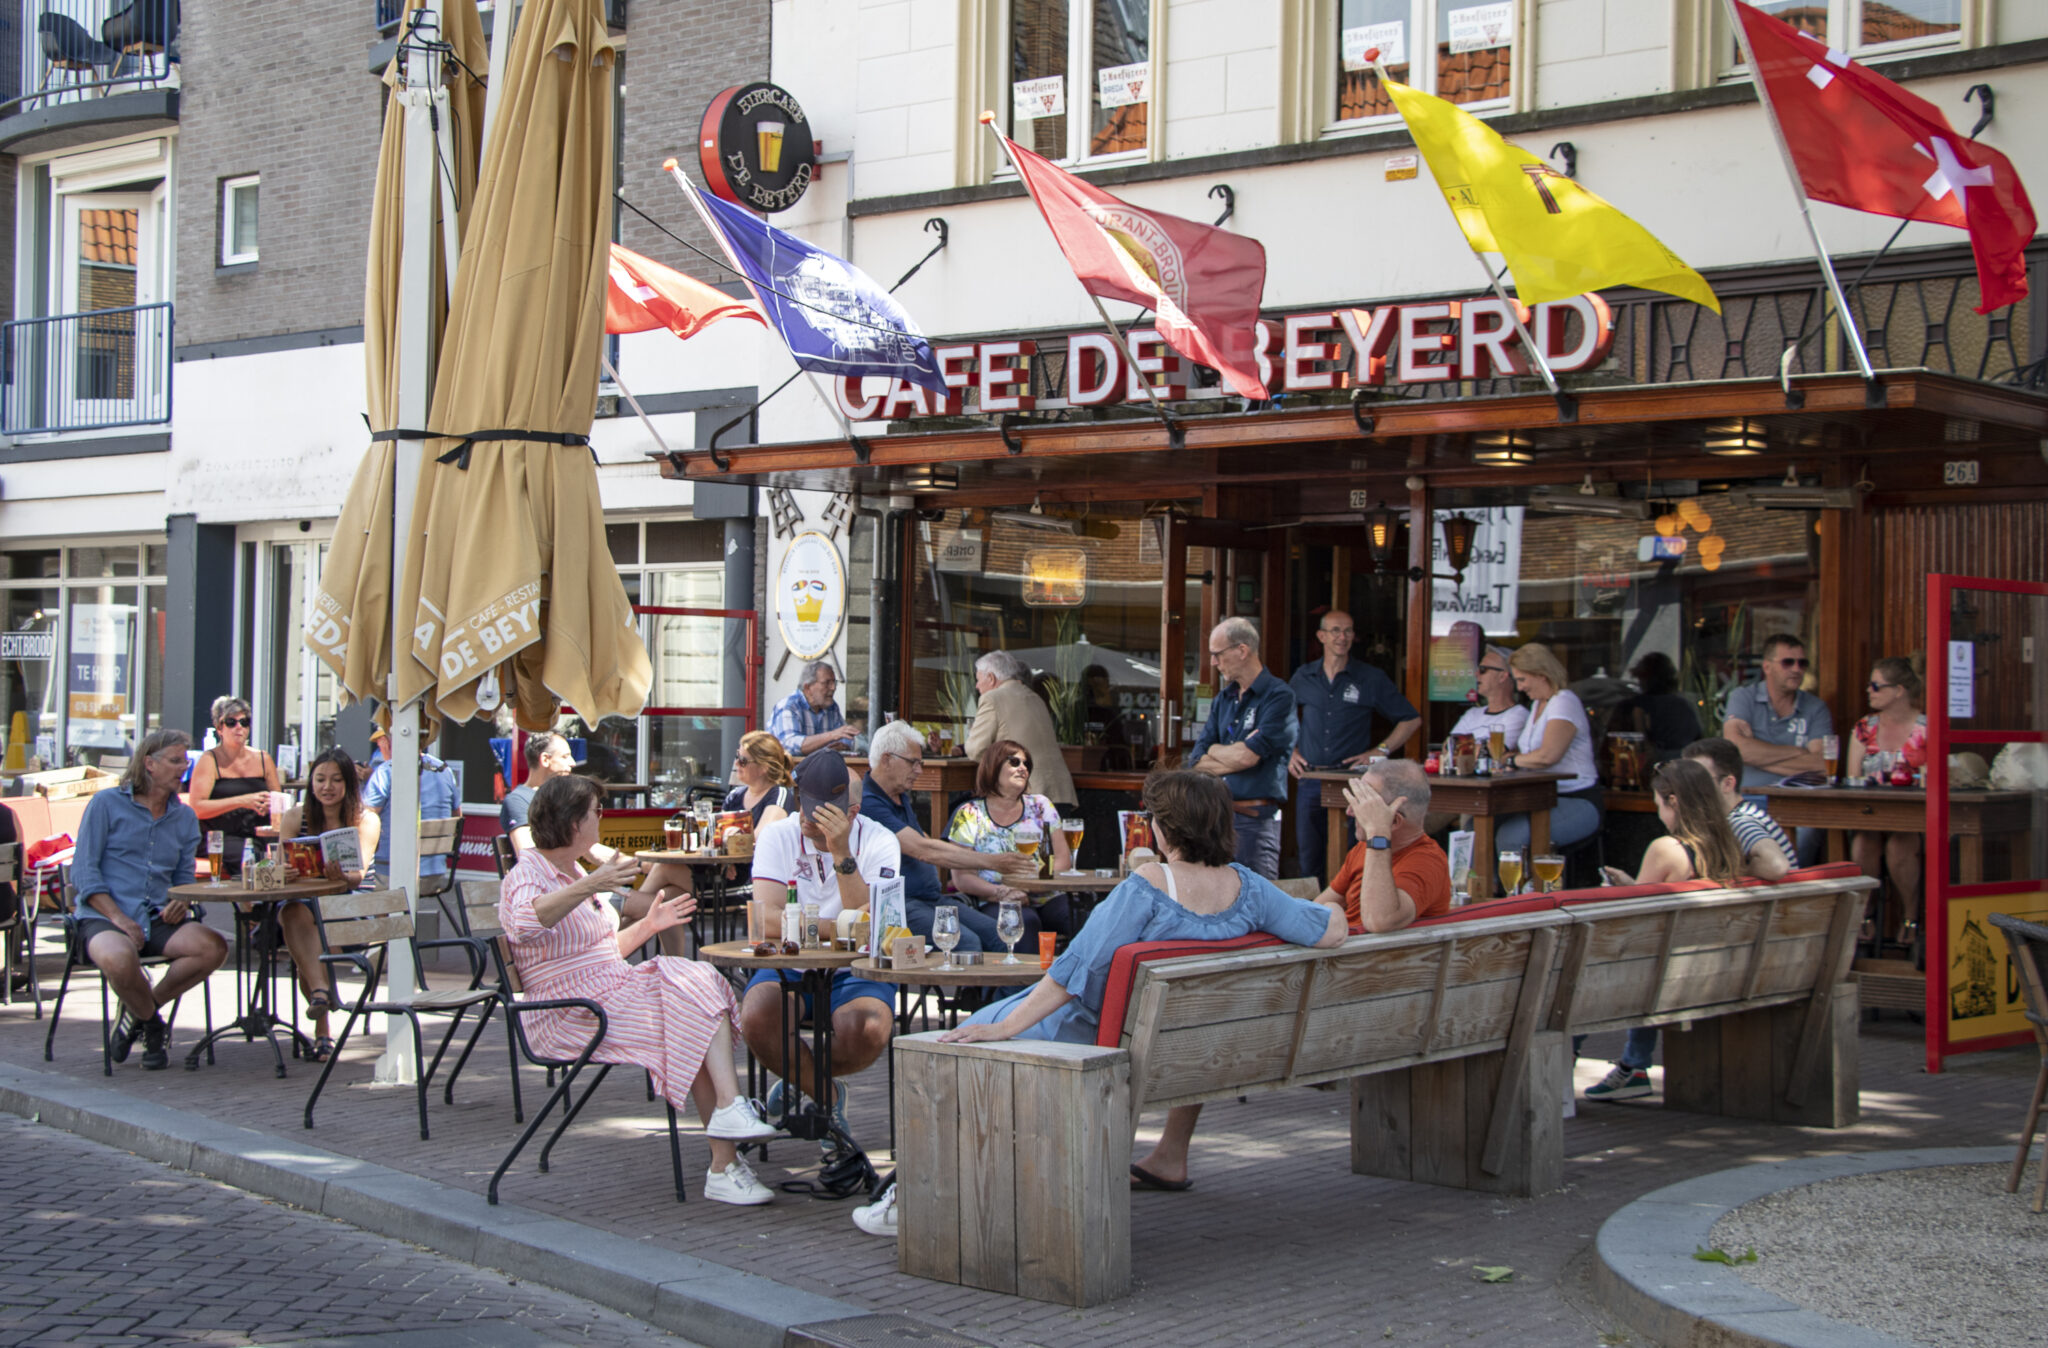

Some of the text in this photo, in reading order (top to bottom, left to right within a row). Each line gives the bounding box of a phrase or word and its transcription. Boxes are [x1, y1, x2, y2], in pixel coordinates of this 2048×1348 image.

[728, 150, 813, 208] DE BEYERD
[836, 341, 1030, 420] CAFE
[1068, 330, 1180, 406] DE
[1221, 293, 1608, 396] BEYERD
[77, 665, 90, 681] TE
[441, 640, 479, 679] DE
[602, 833, 625, 848] CAFÉ
